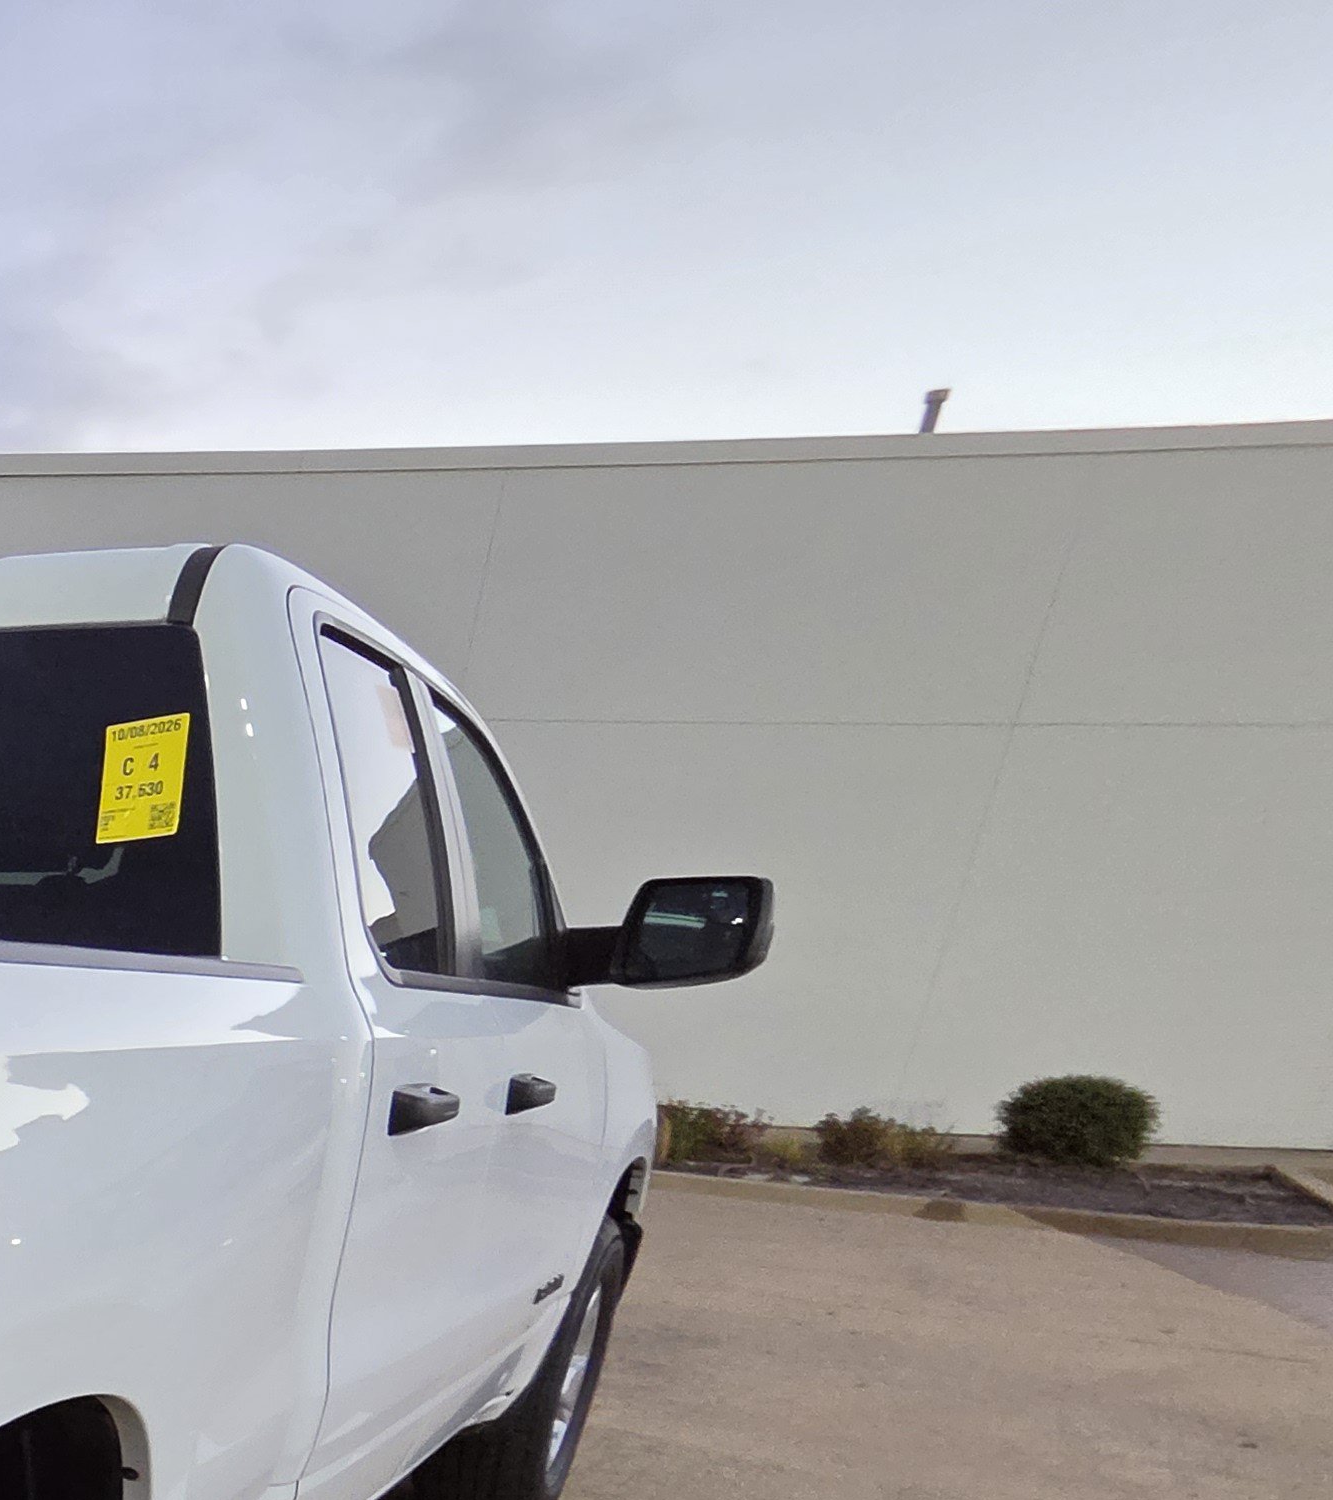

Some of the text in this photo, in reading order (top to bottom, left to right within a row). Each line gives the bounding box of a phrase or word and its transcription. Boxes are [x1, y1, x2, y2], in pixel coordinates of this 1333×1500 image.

[112, 719, 182, 742] 10/08/2026
[122, 752, 160, 776] C 4
